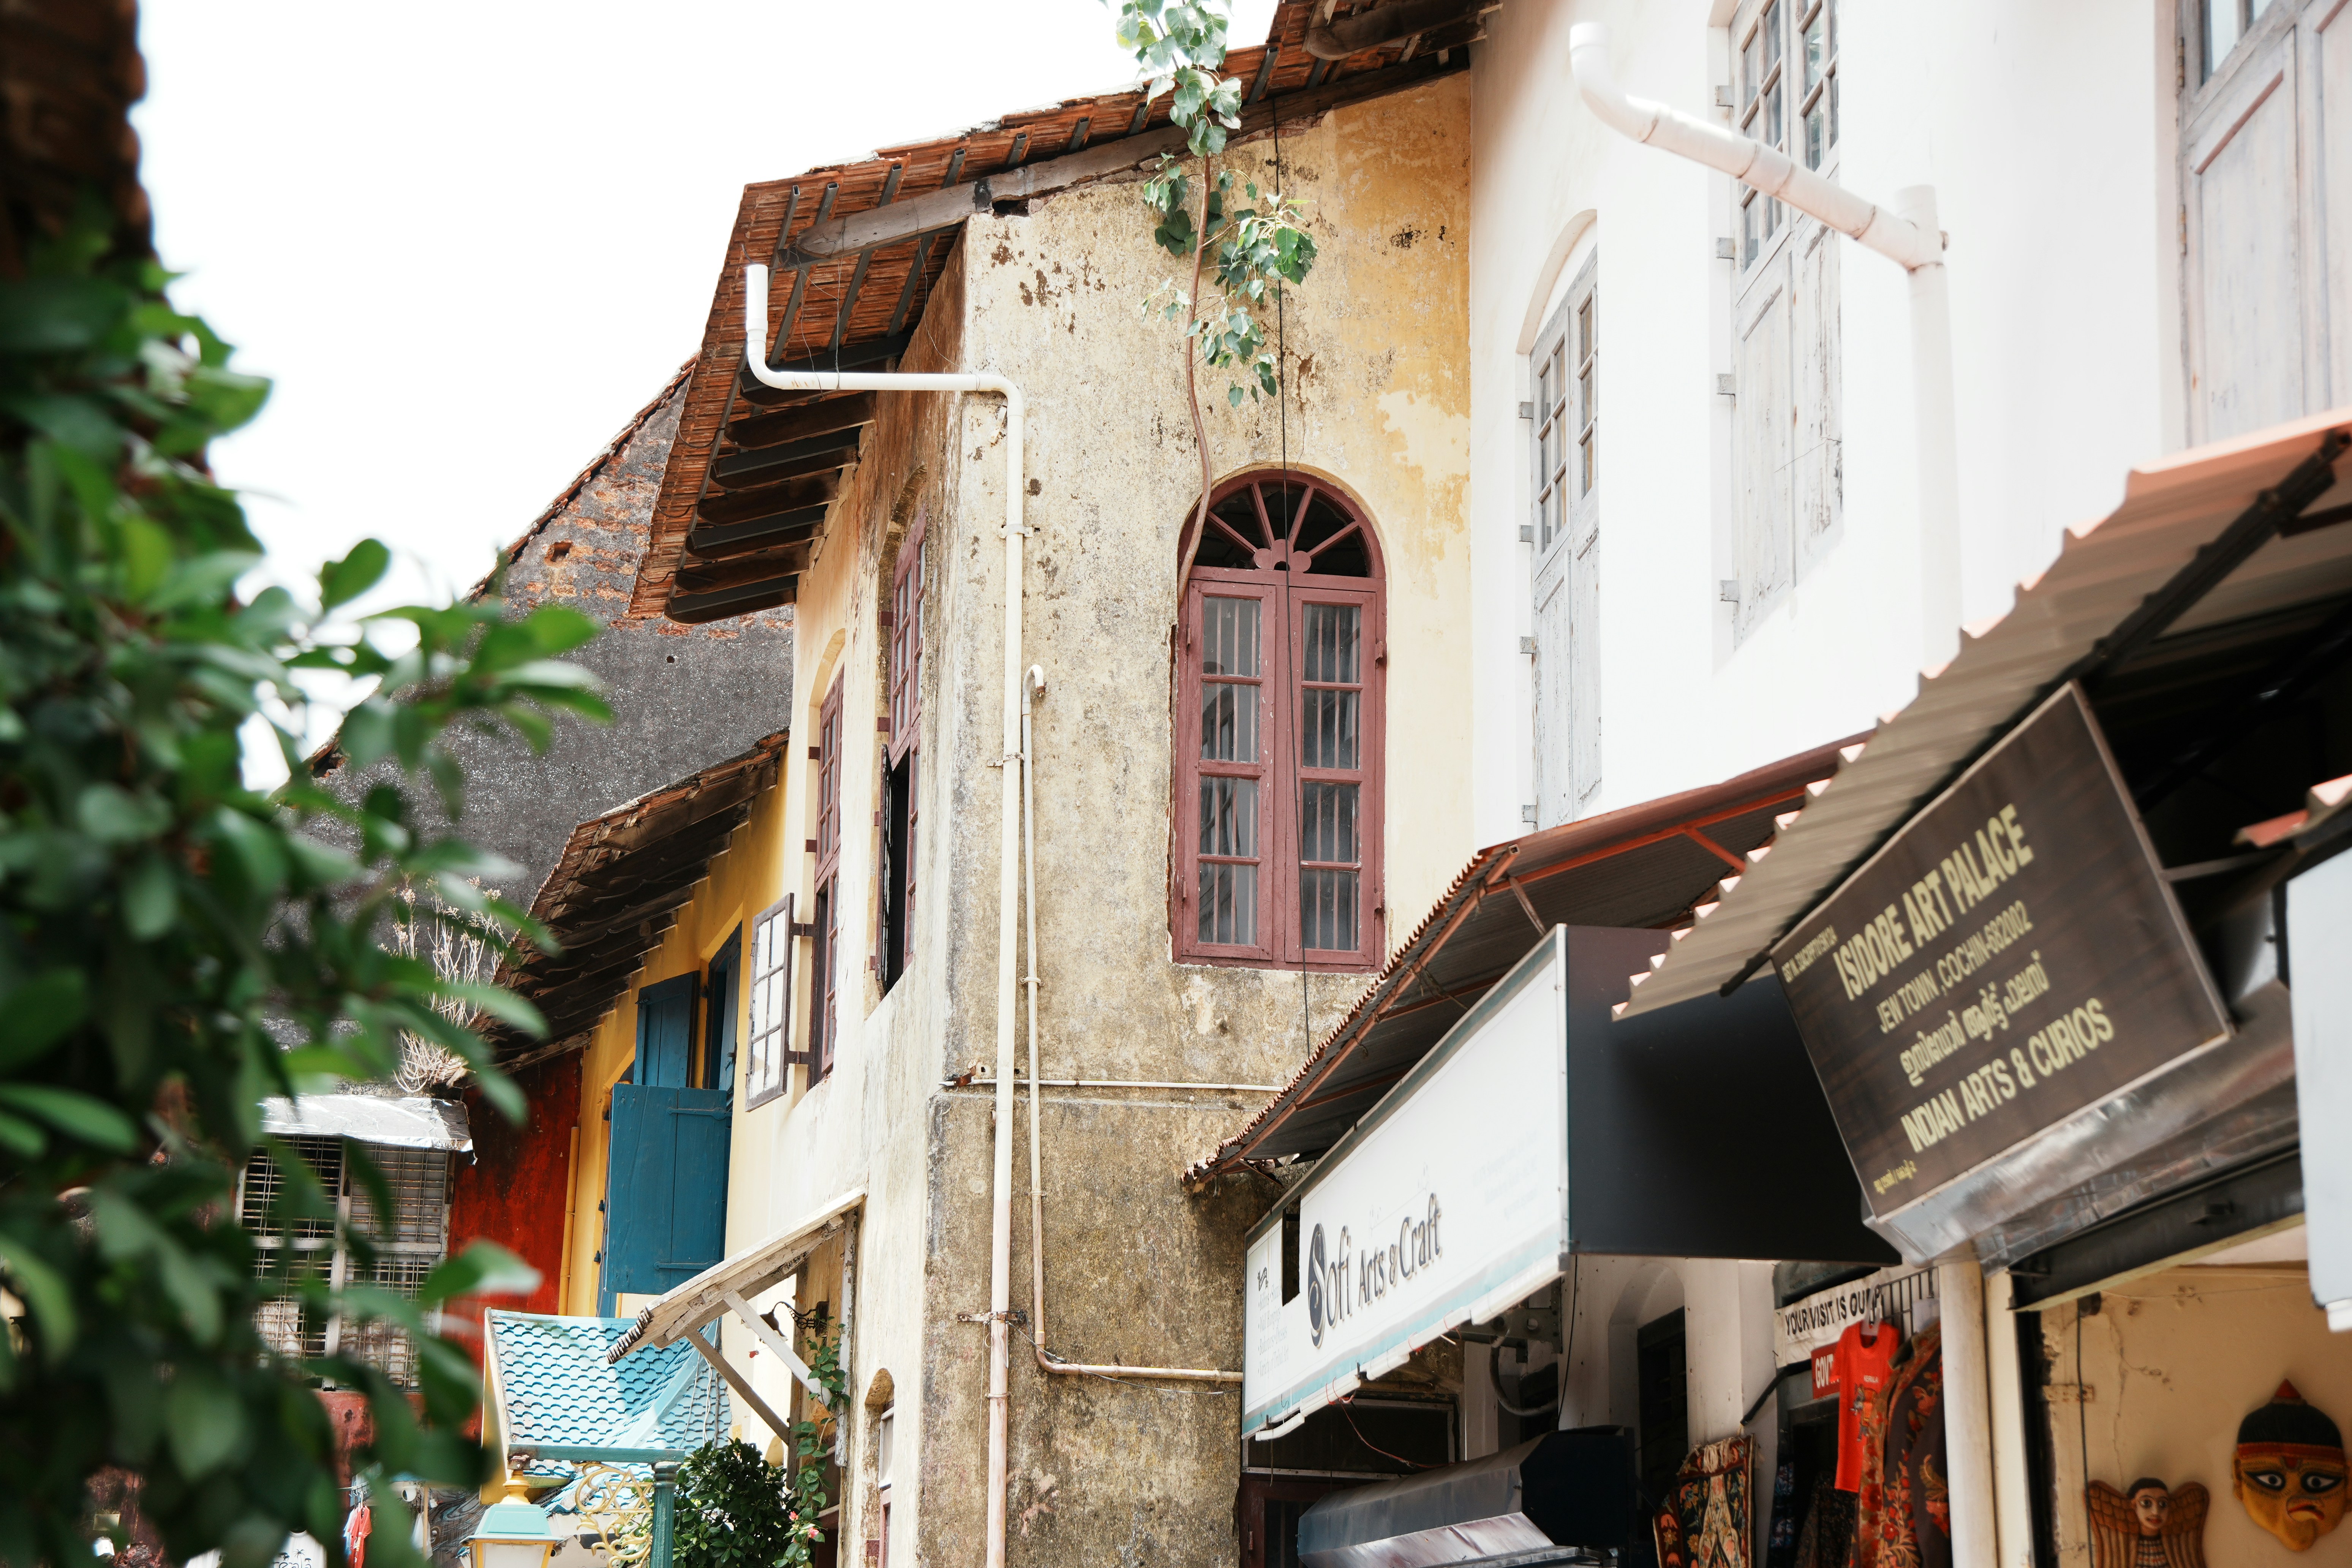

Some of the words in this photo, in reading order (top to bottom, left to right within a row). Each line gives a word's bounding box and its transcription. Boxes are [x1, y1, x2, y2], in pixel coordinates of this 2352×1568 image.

[1832, 903, 1914, 1001] ISIDORE
[1902, 869, 1954, 948] ART
[1940, 803, 2034, 915] PALACE
[1876, 994, 1904, 1034] JEW
[1897, 969, 1939, 1016] TOWN
[1900, 1088, 1966, 1153] INDIAN
[1959, 1058, 2017, 1121] ARTS
[2010, 1047, 2037, 1089] &
[2028, 997, 2115, 1077] CURIOS
[1308, 1223, 1352, 1349] Sofi
[1358, 1247, 1386, 1309] Arts
[1389, 1244, 1398, 1287] &
[1399, 1192, 1442, 1280] Craft
[1260, 1336, 1274, 1355] Bedcovers
[1276, 1326, 1287, 1344] Dresses
[1267, 1307, 1280, 1329] Hangings
[1785, 1309, 1809, 1336] YOUR
[1809, 1300, 1834, 1329] VISIT
[1836, 1295, 1846, 1320] IS
[1260, 1359, 1270, 1378] Variety
[1274, 1347, 1283, 1368] Tribal
